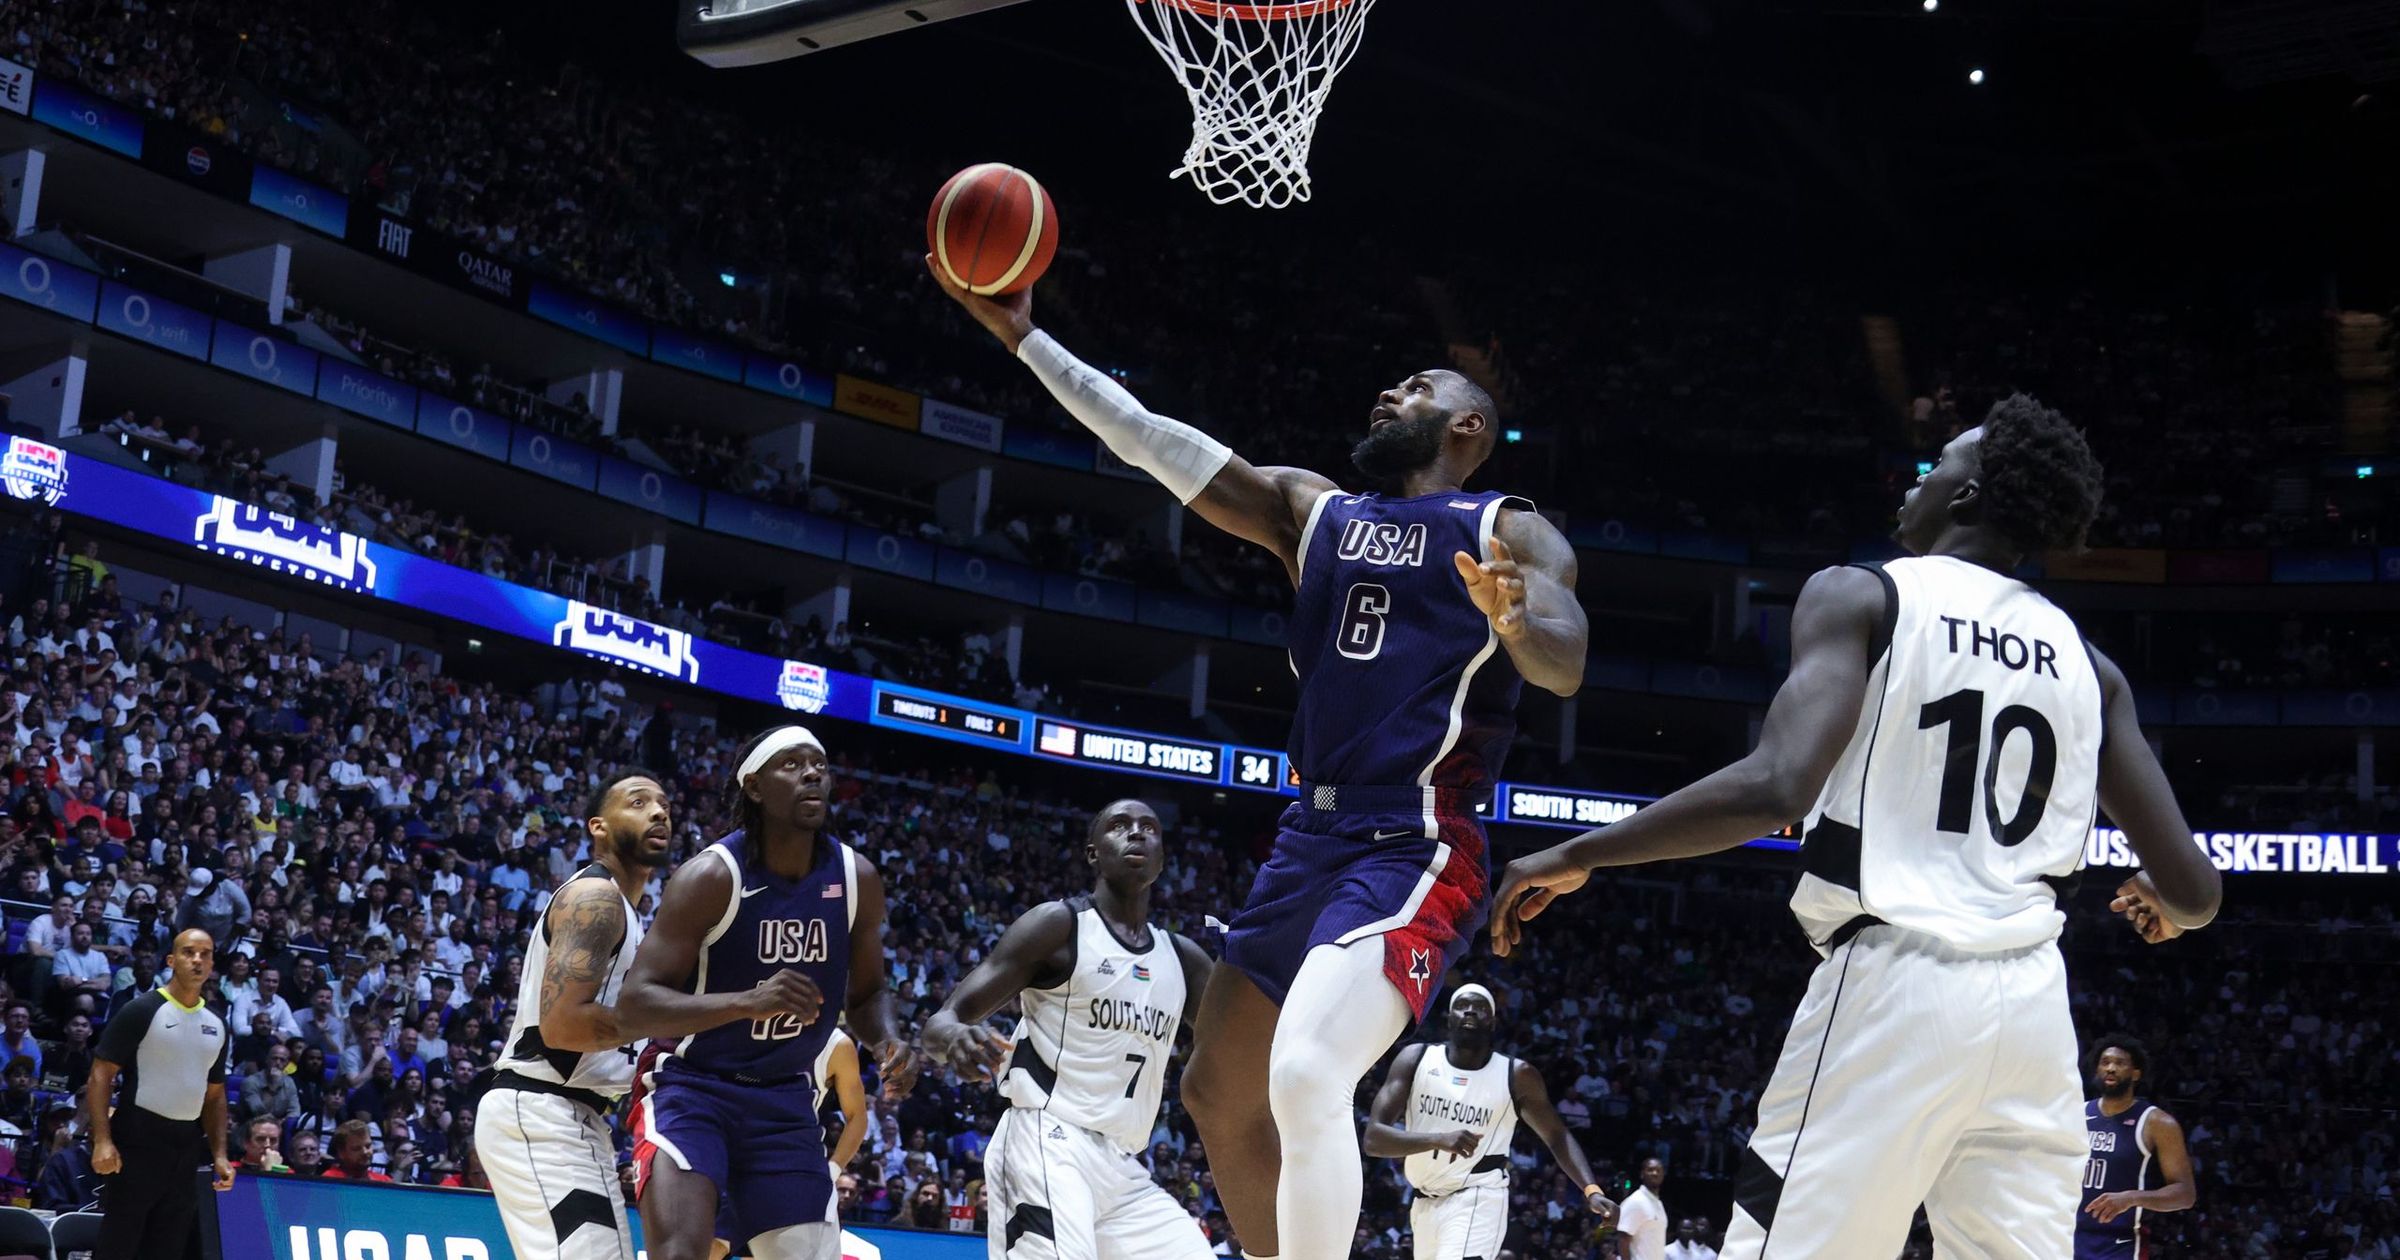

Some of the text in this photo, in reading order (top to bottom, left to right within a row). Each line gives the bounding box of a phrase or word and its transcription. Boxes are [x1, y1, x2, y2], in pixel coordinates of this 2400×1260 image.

[378, 218, 414, 259] FIAT
[458, 251, 512, 286] QATAR
[161, 326, 189, 342] wifi
[341, 374, 396, 410] Priority
[1337, 518, 1427, 567] USA
[1336, 582, 1391, 660] 6
[1940, 614, 2060, 680] THOR
[893, 699, 936, 721] TIMEOUTS
[939, 708, 947, 723] 1
[965, 714, 993, 733] FOULS
[1083, 733, 1145, 765] UNITED
[1148, 743, 1213, 775] STATES
[1241, 756, 1270, 784] 34
[1918, 688, 2058, 847] 10
[1513, 793, 1573, 820] SOUTH
[2086, 828, 2141, 867] US
[758, 918, 828, 964] USA
[1089, 998, 1144, 1035] SOUTH
[1124, 1053, 1147, 1099] 7
[1419, 1094, 1493, 1127] SOUTH SUDAN
[2083, 1157, 2108, 1190] 11
